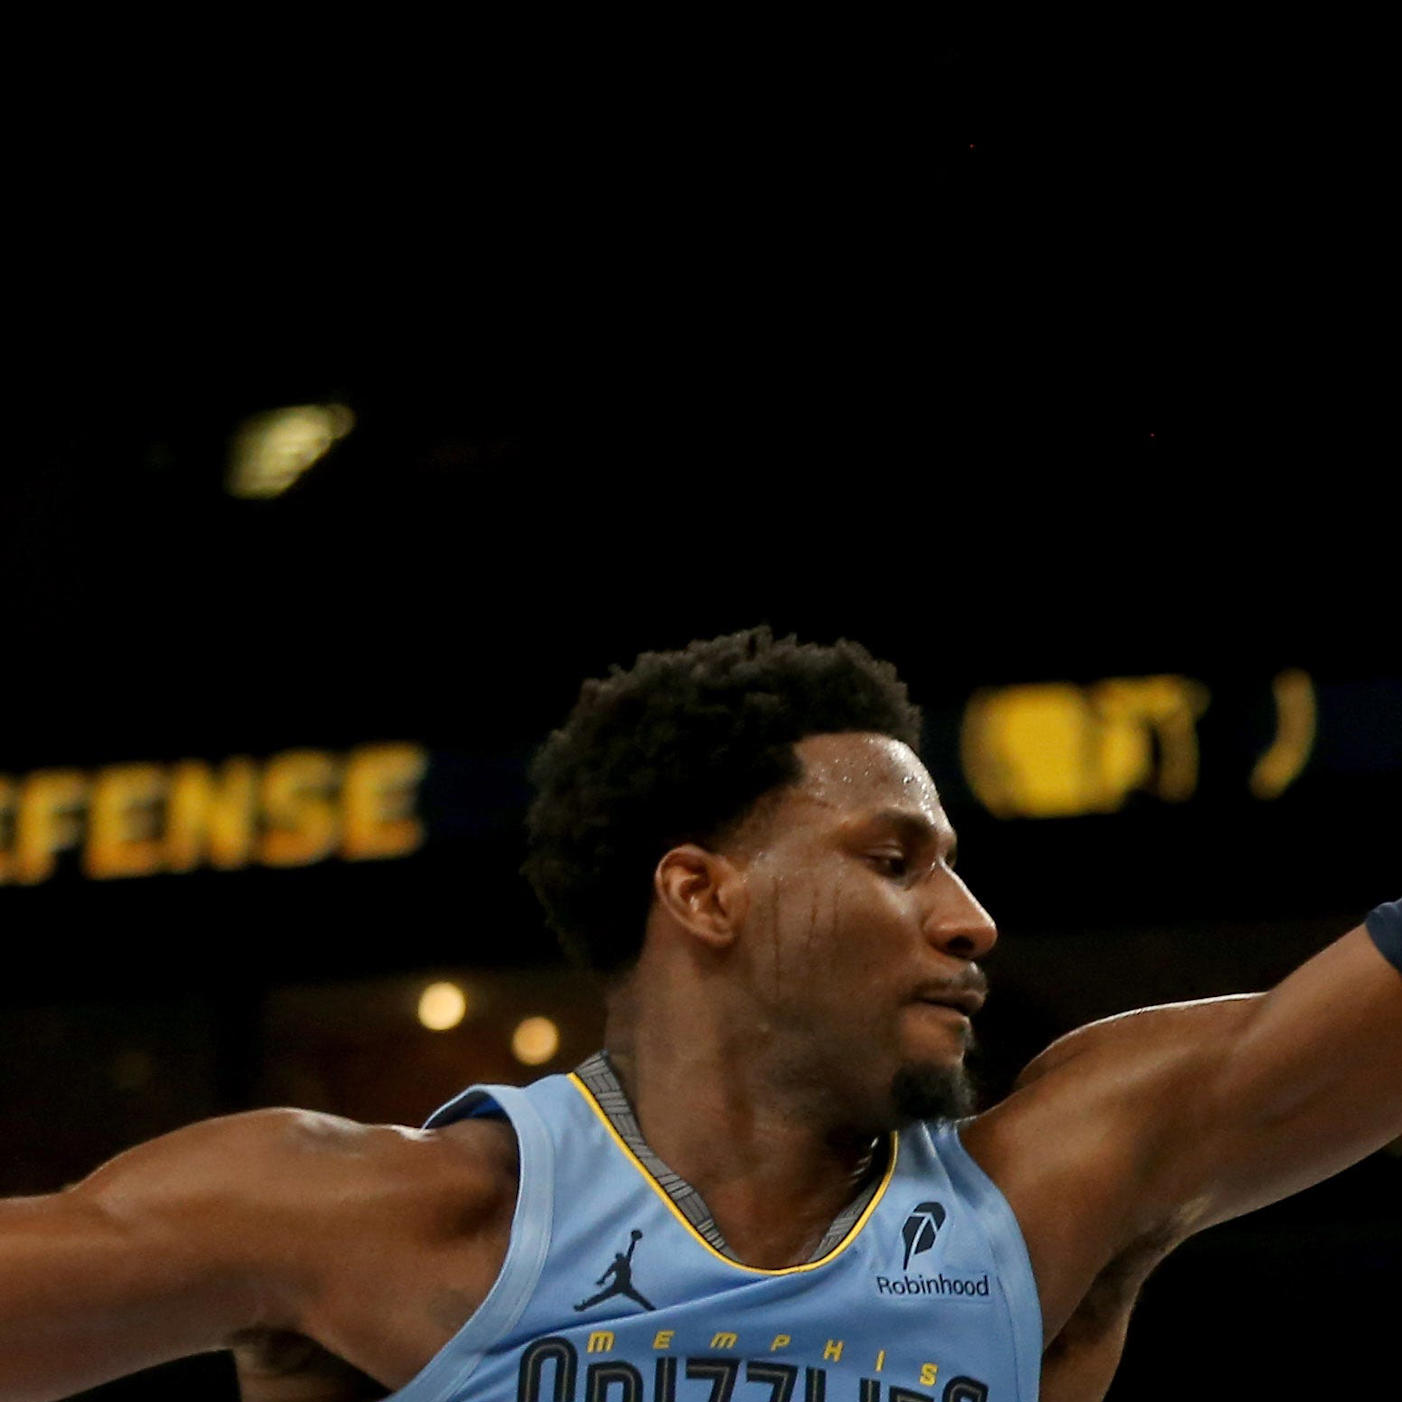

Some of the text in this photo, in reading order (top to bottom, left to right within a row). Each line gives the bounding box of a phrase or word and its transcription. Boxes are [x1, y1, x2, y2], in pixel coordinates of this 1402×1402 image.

[0, 744, 426, 884] FENSE
[877, 1272, 990, 1297] Robinhood
[587, 1328, 940, 1387] MEMPHIS
